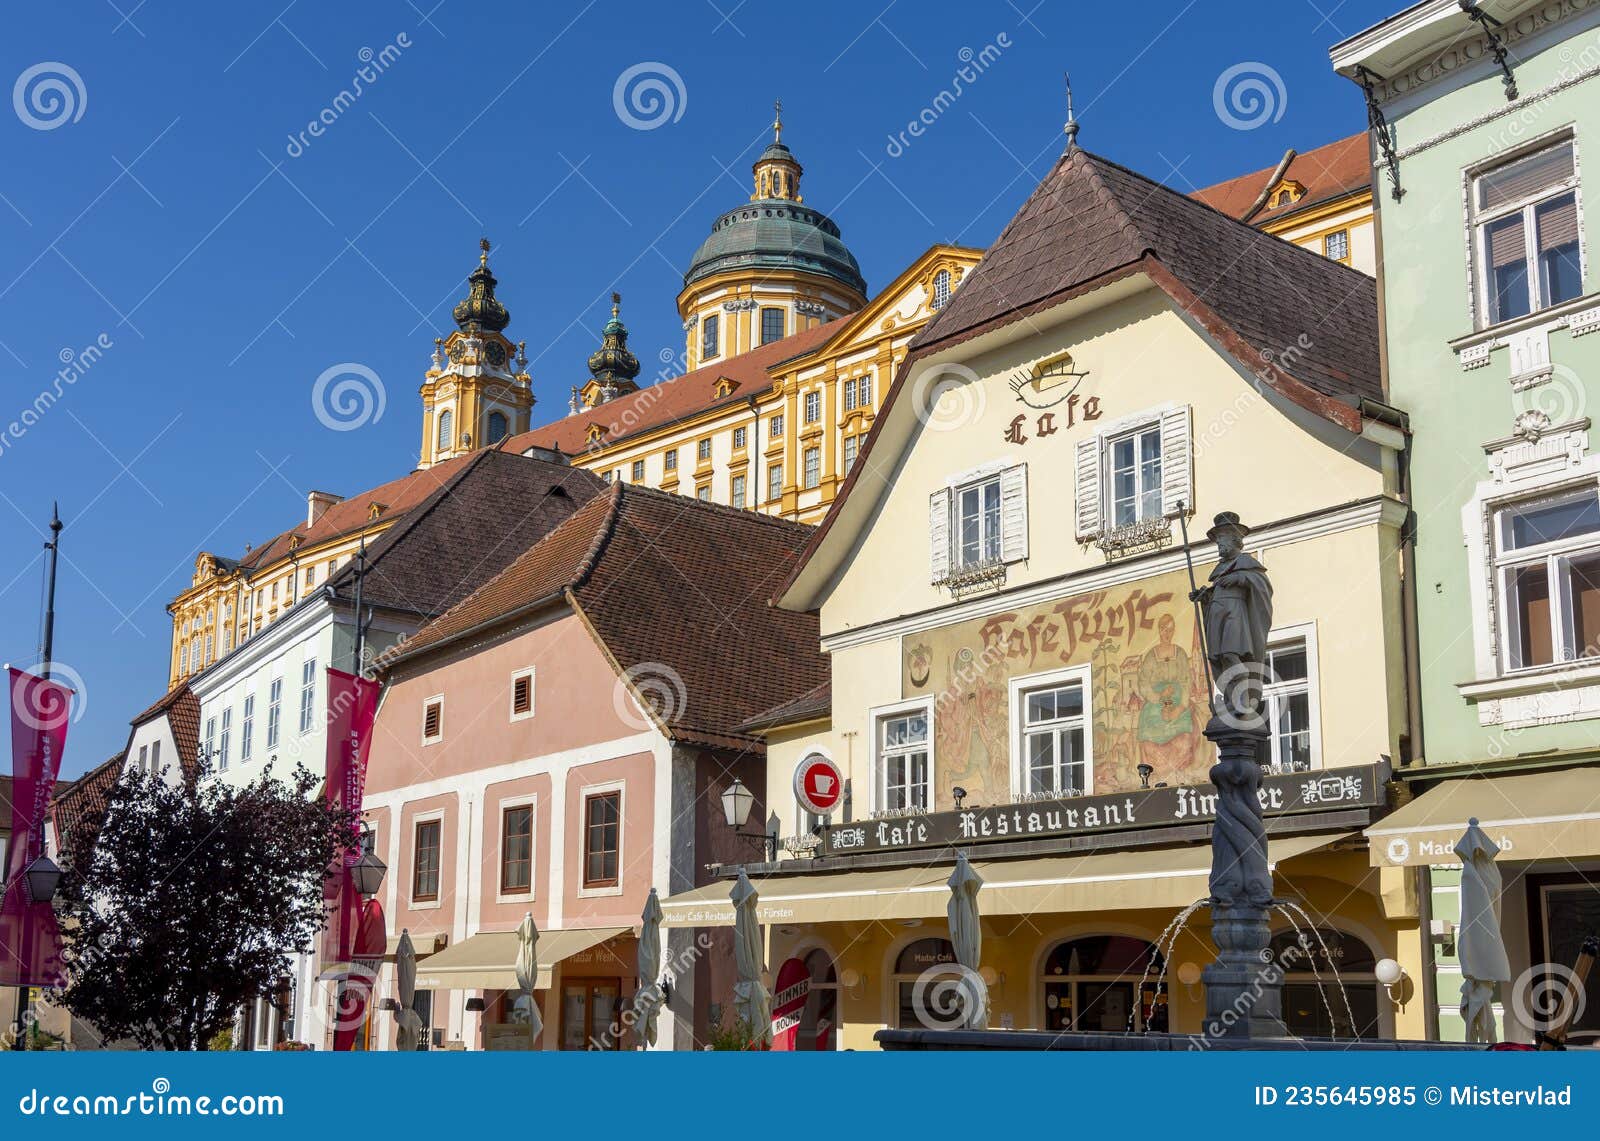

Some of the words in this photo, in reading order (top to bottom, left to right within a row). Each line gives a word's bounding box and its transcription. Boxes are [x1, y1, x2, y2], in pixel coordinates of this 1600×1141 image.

[1004, 394, 1103, 445] Cafe
[1052, 589, 1173, 664] Fürst
[1175, 788, 1284, 819] Zimer
[876, 819, 928, 846] Cafe
[959, 798, 1136, 839] Restaurant
[1419, 840, 1456, 856] Mad
[778, 980, 809, 1006] ZIMMER
[776, 1010, 801, 1032] ROOMS
